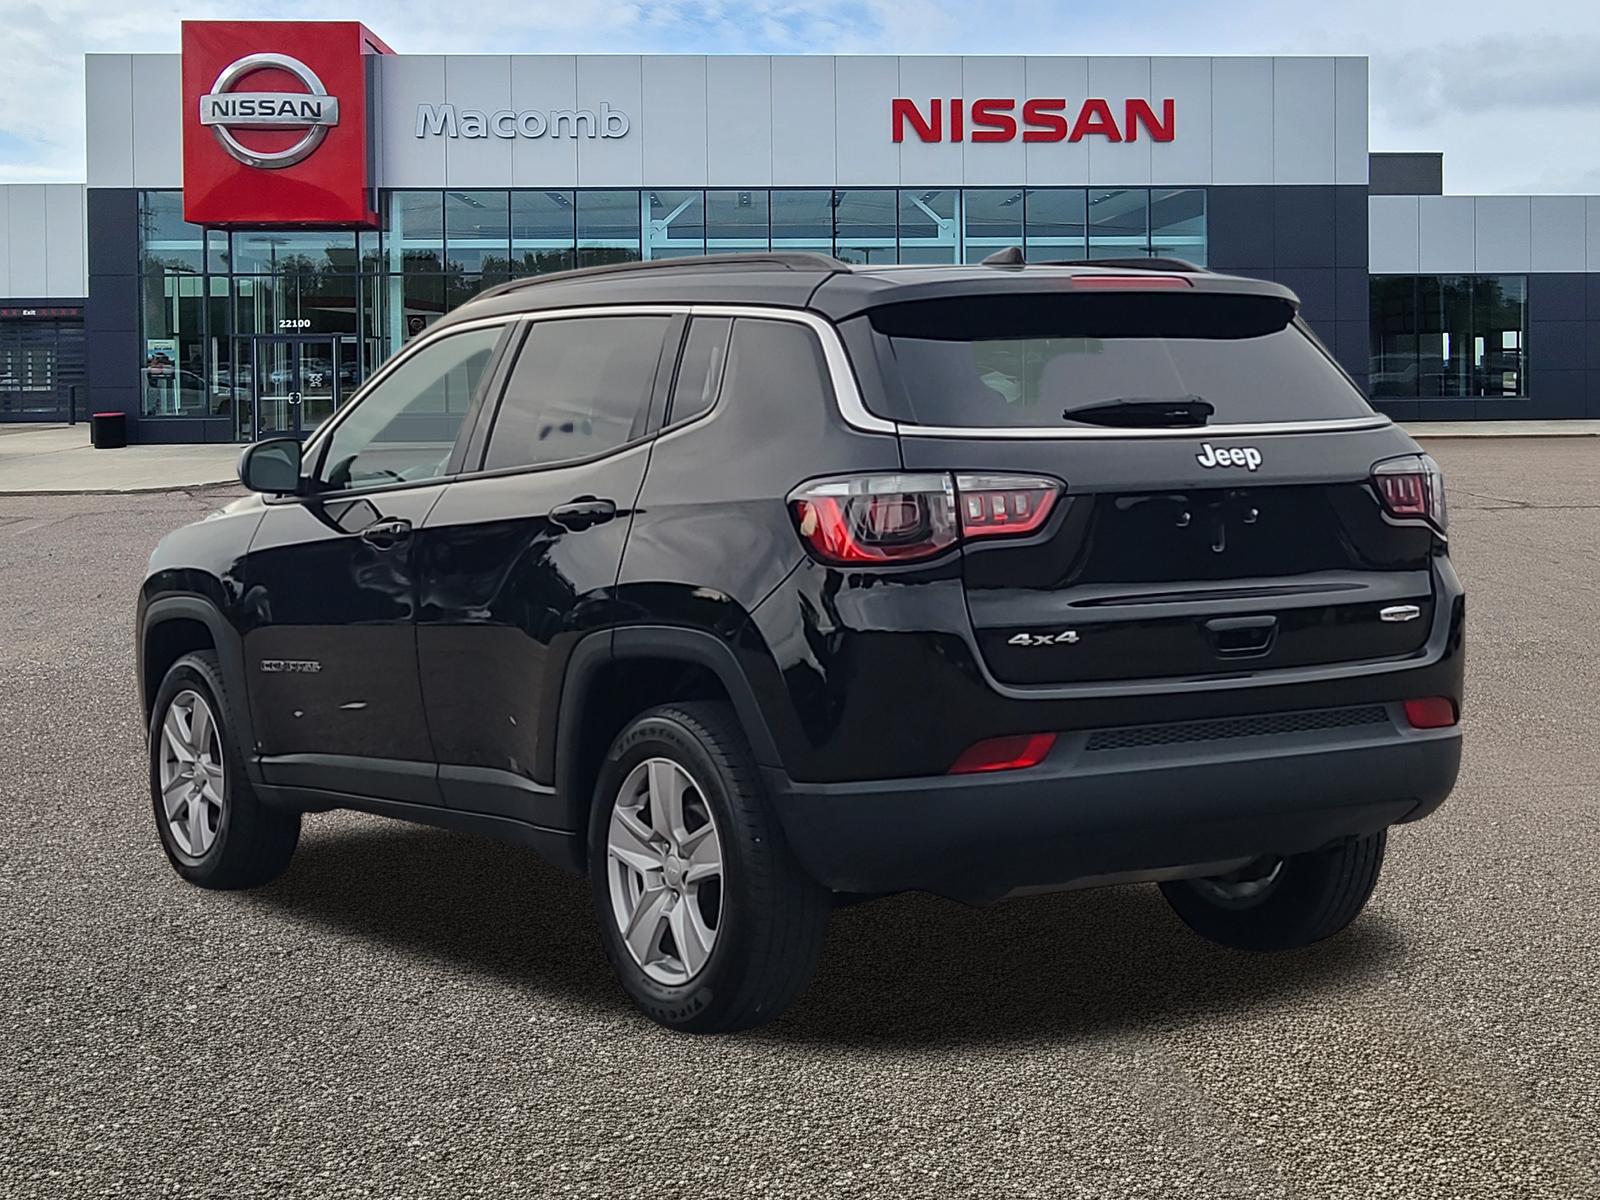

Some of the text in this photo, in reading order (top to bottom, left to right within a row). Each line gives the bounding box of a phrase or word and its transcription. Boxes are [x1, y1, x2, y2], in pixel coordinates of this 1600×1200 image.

[211, 100, 321, 117] NISSAN
[415, 102, 630, 138] Macomb
[892, 98, 1175, 142] NISSAN
[279, 319, 311, 328] 22100
[1196, 443, 1263, 472] Jeep
[1008, 630, 1080, 646] 4x4
